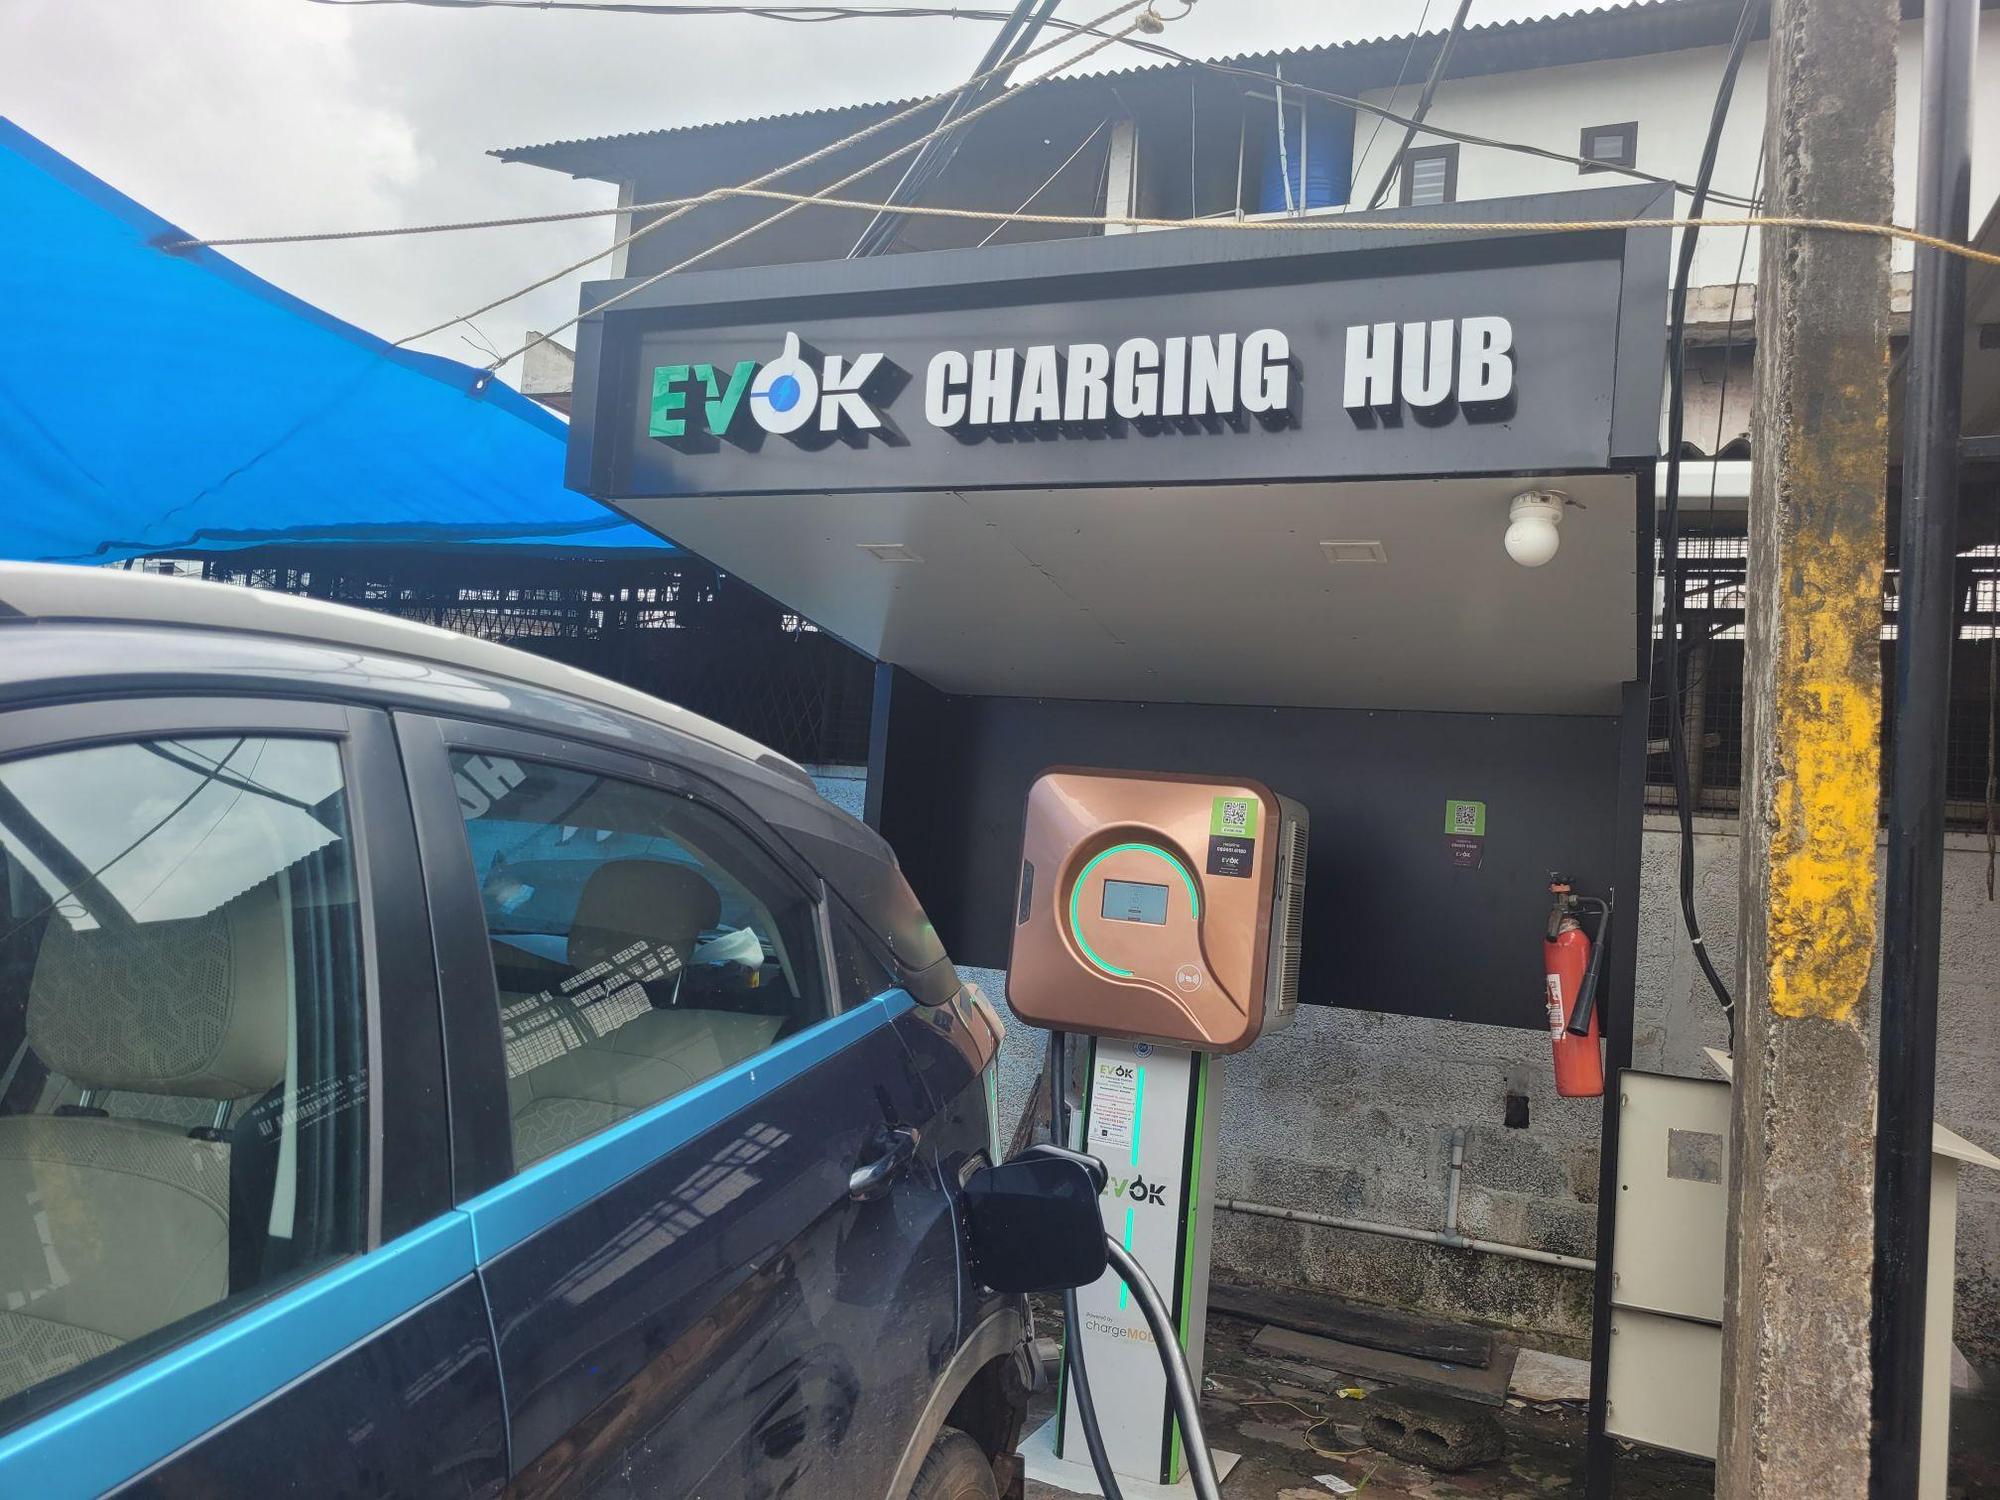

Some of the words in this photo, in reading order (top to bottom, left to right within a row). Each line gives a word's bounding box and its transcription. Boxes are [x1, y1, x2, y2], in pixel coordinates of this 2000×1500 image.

[649, 331, 885, 437] EVOK
[925, 328, 1290, 428] CHARGING
[1343, 316, 1513, 408] HUB
[1100, 1064, 1134, 1079] EVOK
